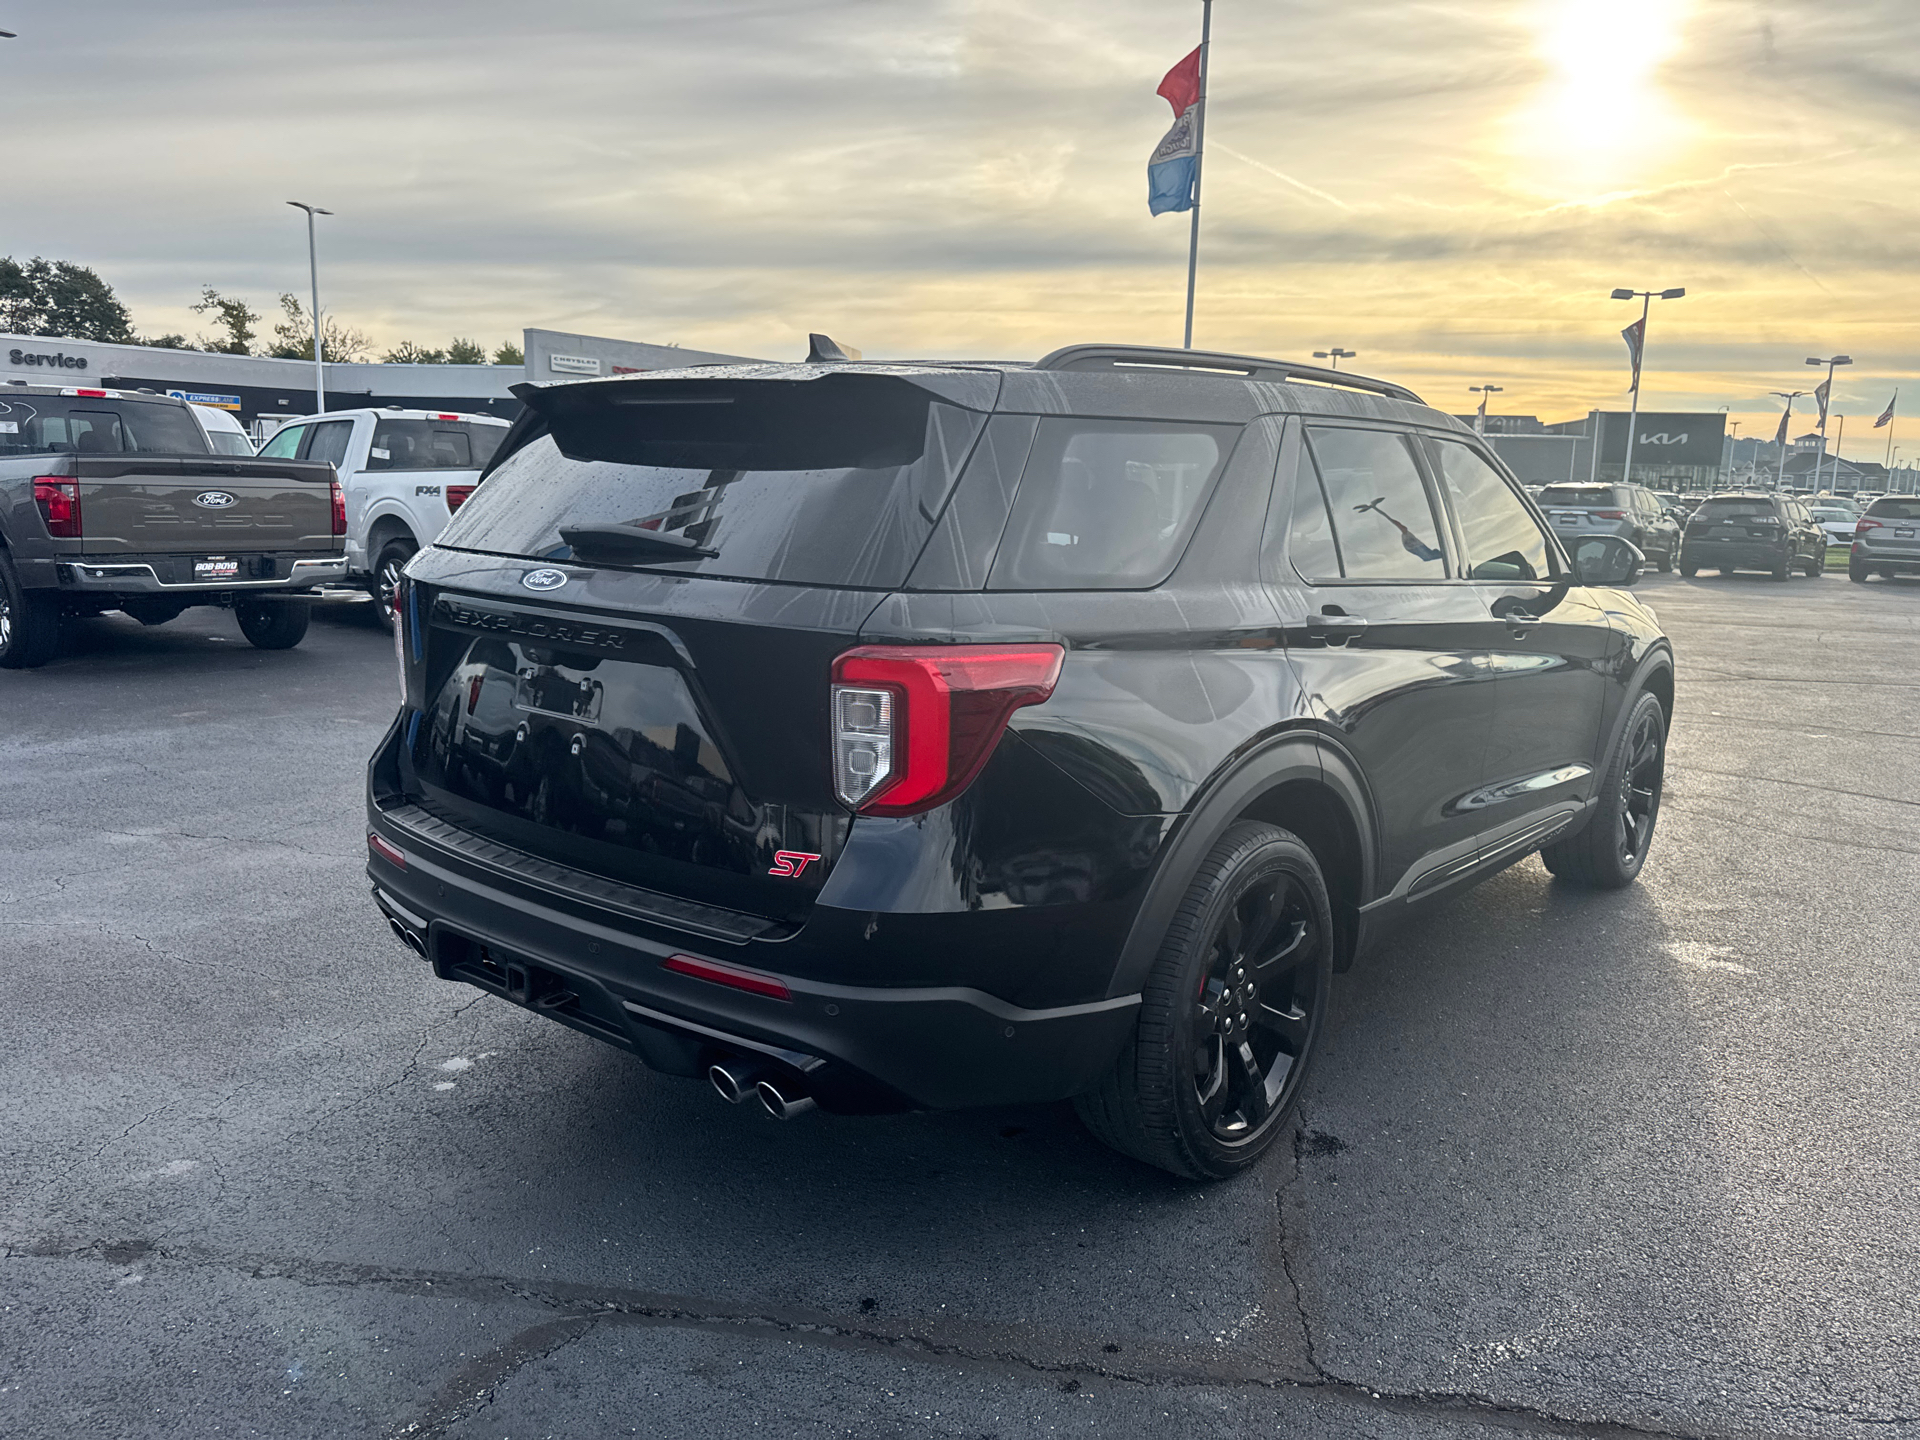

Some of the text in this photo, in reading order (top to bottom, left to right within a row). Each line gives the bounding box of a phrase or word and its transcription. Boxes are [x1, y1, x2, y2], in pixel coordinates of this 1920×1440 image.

[9, 349, 88, 369] Service
[553, 356, 597, 365] CHRYSLER
[1640, 433, 1688, 444] KIA
[416, 486, 440, 496] FX4
[203, 494, 228, 504] Ford
[454, 610, 625, 649] EXPLORER
[768, 849, 821, 878] ST
